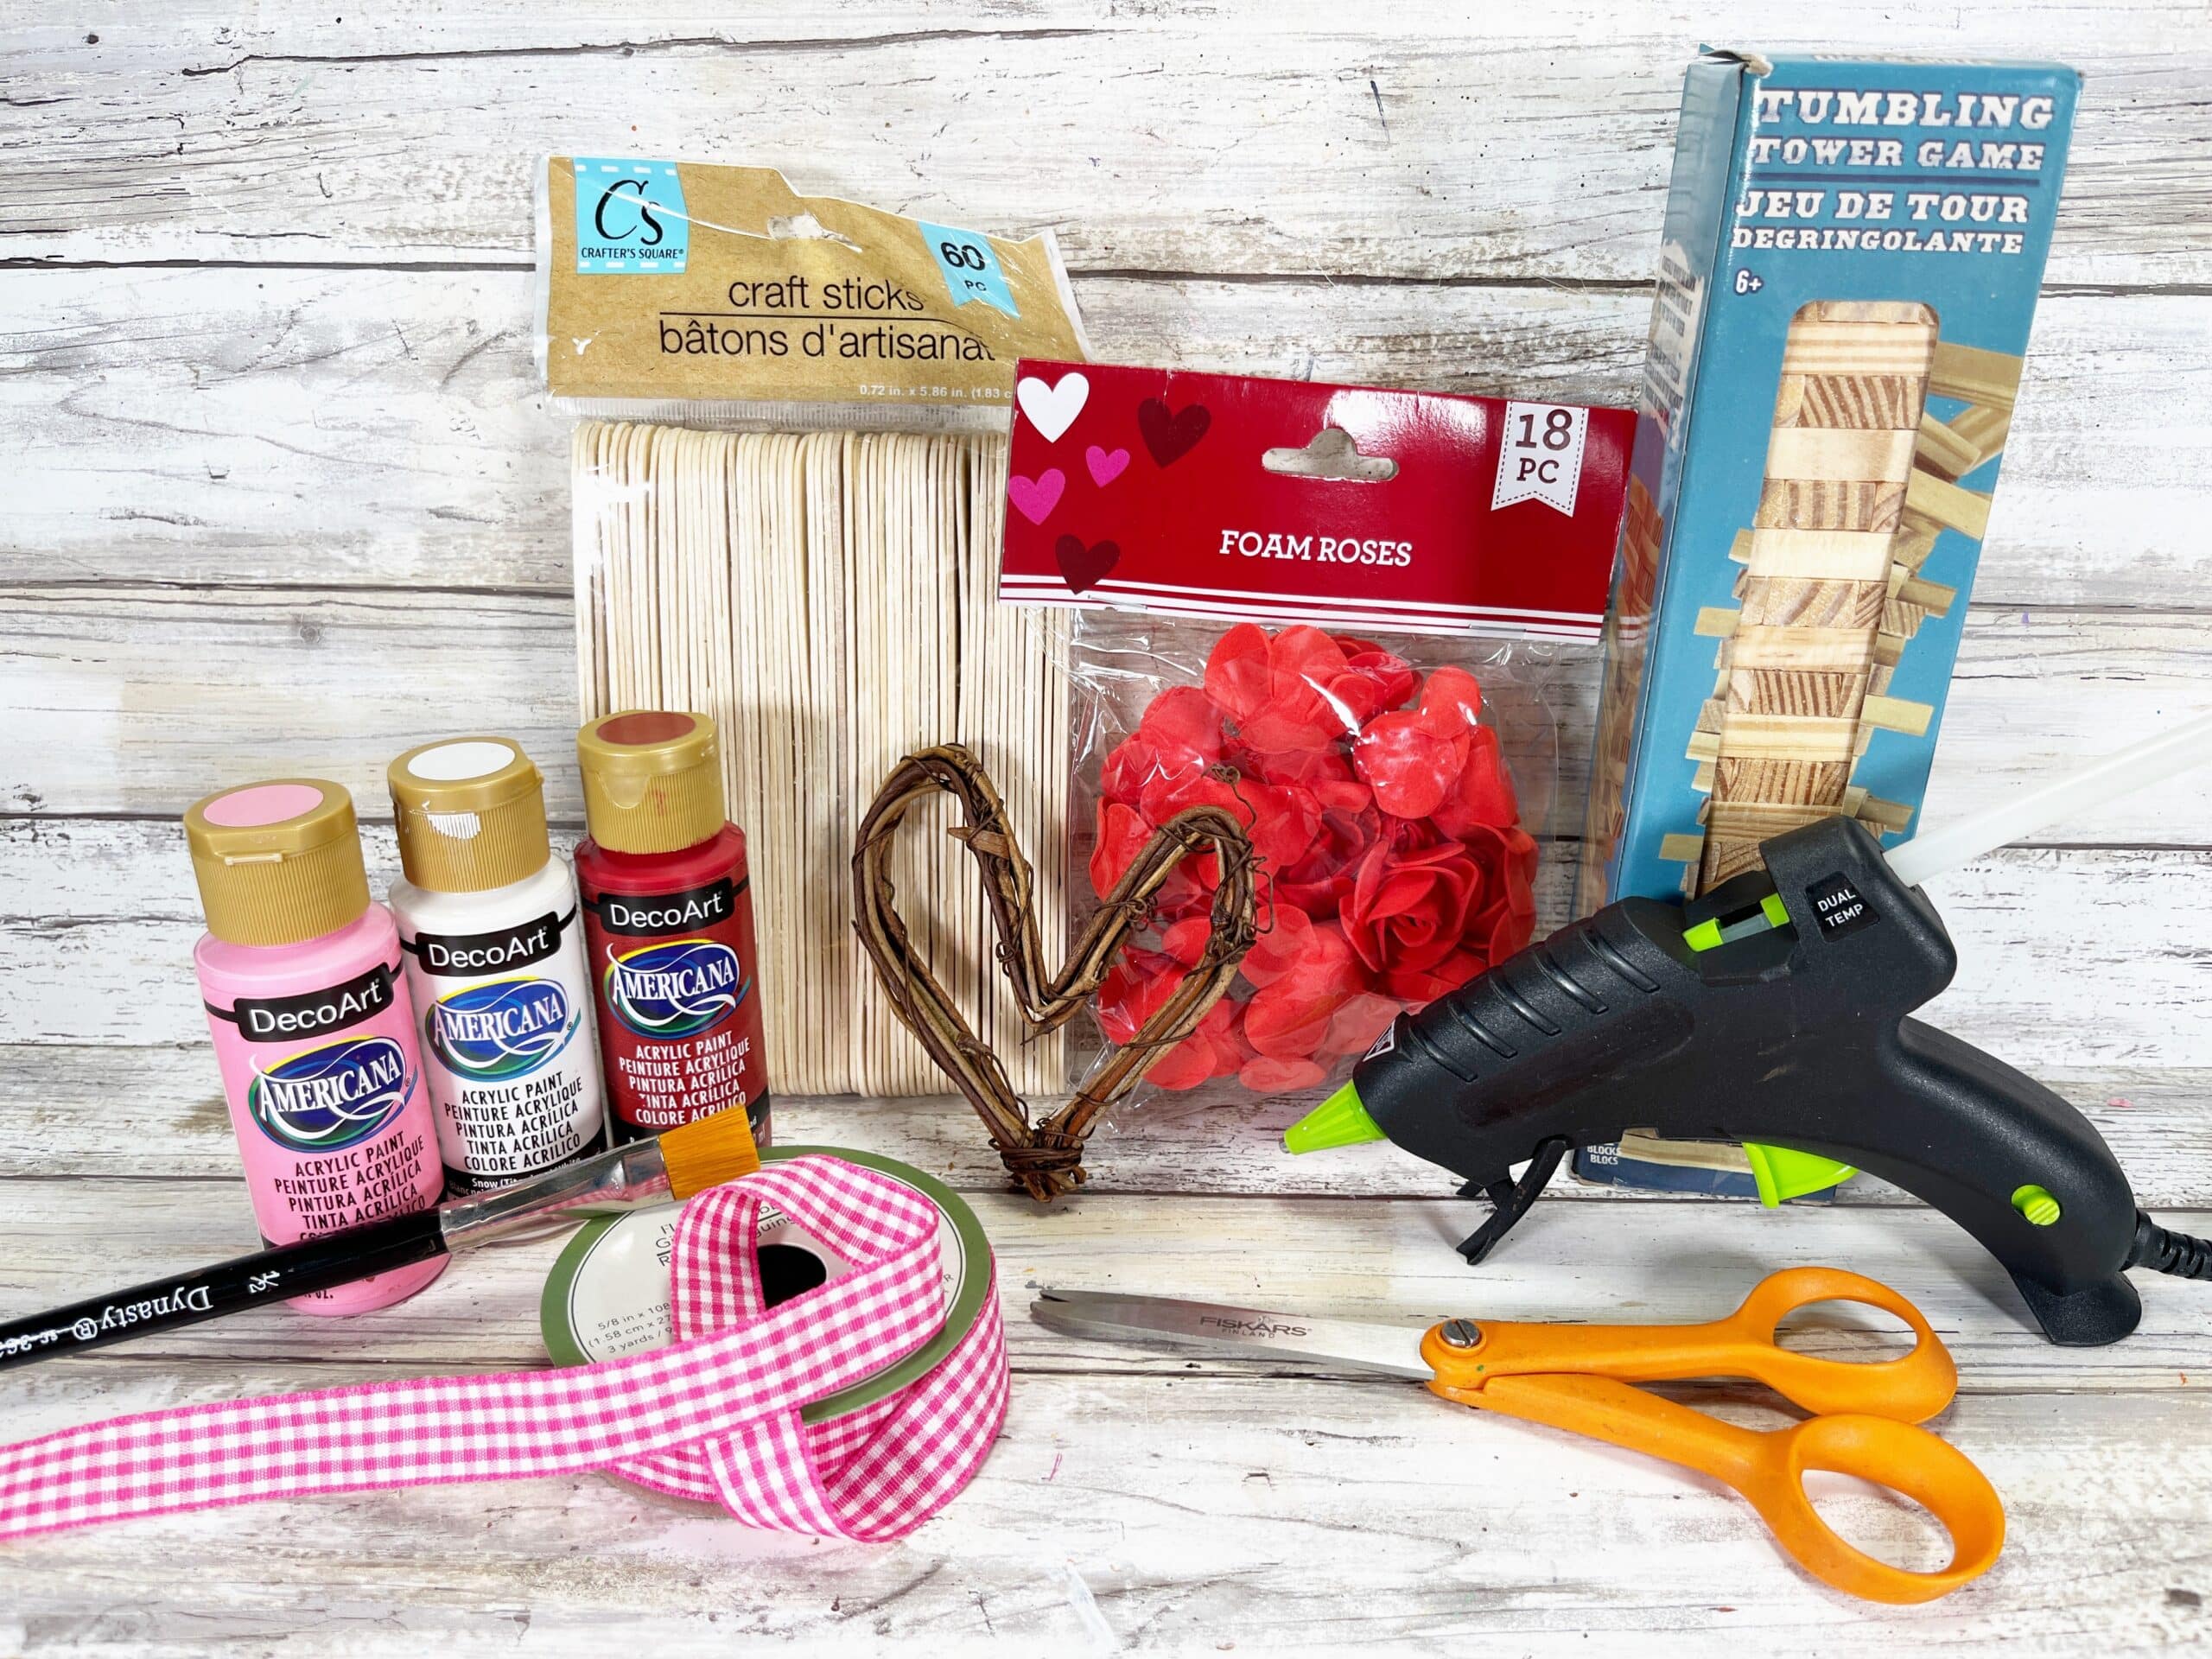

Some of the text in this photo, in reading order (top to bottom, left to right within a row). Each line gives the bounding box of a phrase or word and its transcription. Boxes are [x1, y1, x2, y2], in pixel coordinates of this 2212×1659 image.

[1760, 89, 2054, 130] TUMBLING
[1753, 137, 2046, 171] TOWER GAME
[1735, 189, 2030, 224] JEU DE TOUR
[581, 247, 636, 259] CRAFTER'S
[939, 241, 987, 272] 60
[1731, 227, 2025, 255] DEGRINGOLANTE
[728, 275, 925, 312] craft sticks
[963, 280, 988, 292] PC
[1734, 268, 1764, 296] 6+
[659, 318, 789, 357] bâtons
[859, 385, 886, 397] 0.72
[888, 385, 905, 397] in.
[908, 387, 916, 397] x
[919, 386, 948, 398] 5.86
[950, 386, 968, 398] in.
[1516, 407, 1573, 450] 18
[1516, 456, 1560, 486] PC
[1219, 528, 1414, 568] FOAM ROSES
[609, 891, 724, 928] DecoArt
[1817, 888, 1857, 913] DUAL
[1824, 903, 1864, 928] TEMP
[429, 928, 550, 969] DecoArt
[612, 956, 735, 1006] AMERICANA
[249, 980, 384, 1034] DecoArt
[435, 992, 564, 1047] AMERICANA
[618, 1037, 751, 1077] PEINTURE ACRYLIQUE
[635, 1030, 734, 1060] ACRYLIC PAINT
[259, 1050, 403, 1122] AMERICANA
[461, 1071, 564, 1106] ACRYLIC PAINT
[628, 1060, 747, 1094] PINTURA ACRÍLICA
[682, 1078, 741, 1109] ACRÍLICA
[444, 1077, 583, 1122] PEINTURE ACRYLIQUE
[635, 1107, 687, 1126] COLORE
[455, 1102, 580, 1140] PINTURA ACRÍLICA
[466, 1120, 574, 1156] TINTA ACRÍLICA
[274, 1135, 425, 1196] PEINTURE ACRYLIQUE
[295, 1130, 406, 1178] ACRYLIC PAINT
[464, 1155, 518, 1173] COLORE
[523, 1131, 582, 1168] ACRILICO
[1590, 1154, 1618, 1166] BLOCS
[288, 1163, 423, 1213] PINTURA ACRÍLICA
[471, 1178, 499, 1189] Snow
[302, 1186, 418, 1231] TINTA ACRÍLICA
[597, 1319, 620, 1331] 5/8
[622, 1314, 635, 1324] in
[647, 1302, 671, 1314] 108
[625, 1325, 645, 1335] cm
[657, 1313, 671, 1325] 27
[1199, 1315, 1307, 1337] FISKARS
[1221, 1327, 1276, 1339] FINLAND
[607, 1345, 616, 1354] 3
[620, 1333, 655, 1352] yards
[664, 1326, 673, 1335] 9
